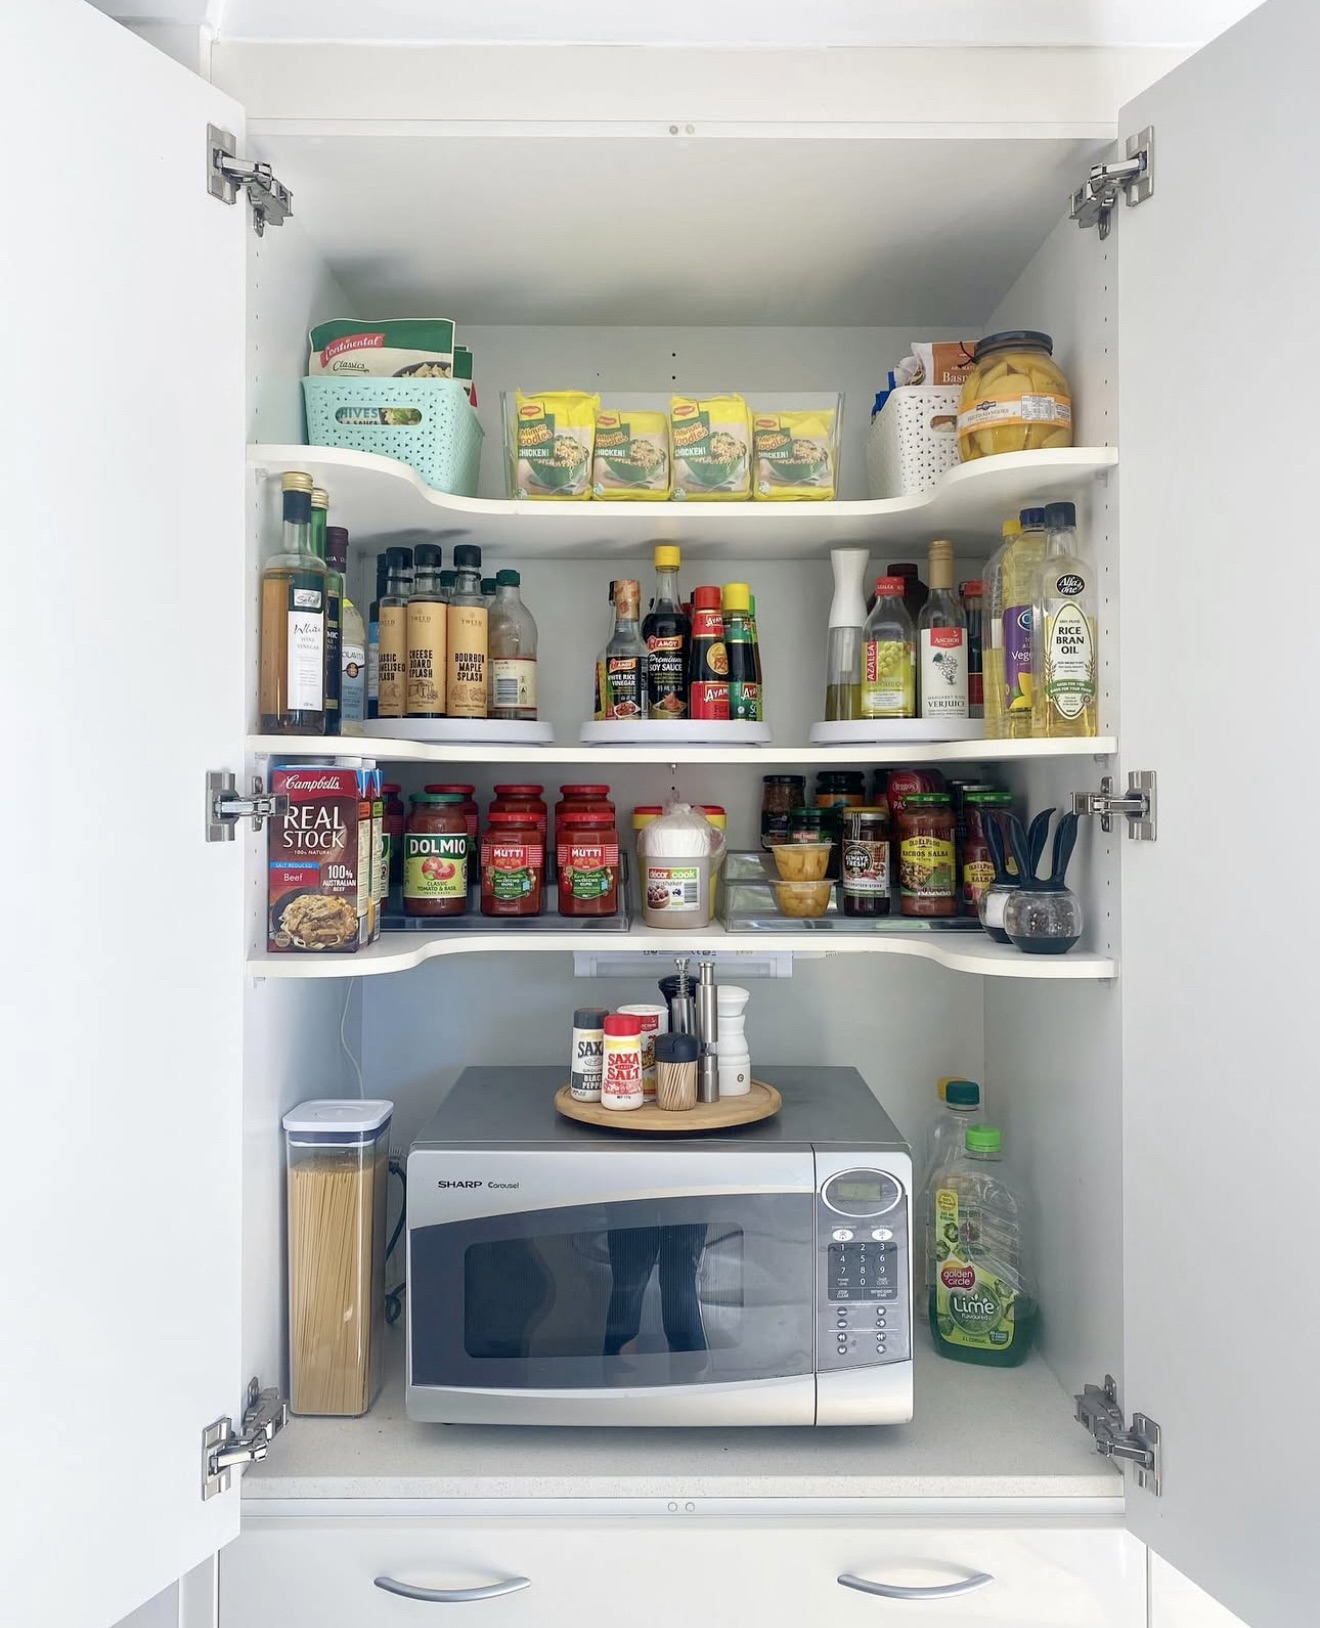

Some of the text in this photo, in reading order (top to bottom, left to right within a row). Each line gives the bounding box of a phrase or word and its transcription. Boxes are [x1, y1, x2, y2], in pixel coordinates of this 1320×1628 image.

[325, 335, 380, 361] Continental
[333, 360, 370, 373] Classics
[1058, 626, 1082, 635] RICE
[1056, 636, 1085, 645] BRAN
[409, 649, 433, 659] CHEESE
[1061, 645, 1079, 654] OIL
[455, 653, 485, 663] BOURBON
[649, 654, 683, 663] Premium
[867, 643, 876, 681] AZALEA
[410, 659, 431, 669] BOARD
[459, 663, 482, 672] MAPLE
[649, 663, 683, 671] SOY SAUCE
[409, 669, 433, 678] SPLASH
[457, 672, 483, 682] SPLASH
[284, 774, 341, 792] Campbell's
[283, 806, 346, 830] REAL
[282, 831, 345, 848] STOCK
[410, 838, 466, 855] DOLMIO
[493, 848, 524, 858] MUTTI
[571, 848, 602, 857] MUTTI
[328, 865, 353, 879] 100%
[671, 869, 696, 879] cook
[284, 873, 303, 882] Beef
[322, 879, 356, 887] AUSTRALIAN
[578, 1040, 603, 1058] SAX
[607, 1052, 640, 1067] SAXA
[583, 1074, 602, 1082] BLAC
[607, 1066, 640, 1080] SALT
[437, 1180, 520, 1189] SHARP Carousel
[841, 1243, 885, 1251] 1 2 3
[860, 1255, 866, 1263] 5
[880, 1254, 885, 1262] 6
[841, 1266, 885, 1274] 7 8 9
[944, 1270, 973, 1280] golden
[860, 1278, 866, 1286] 0
[947, 1277, 971, 1286] circle
[953, 1296, 995, 1315] Lime
